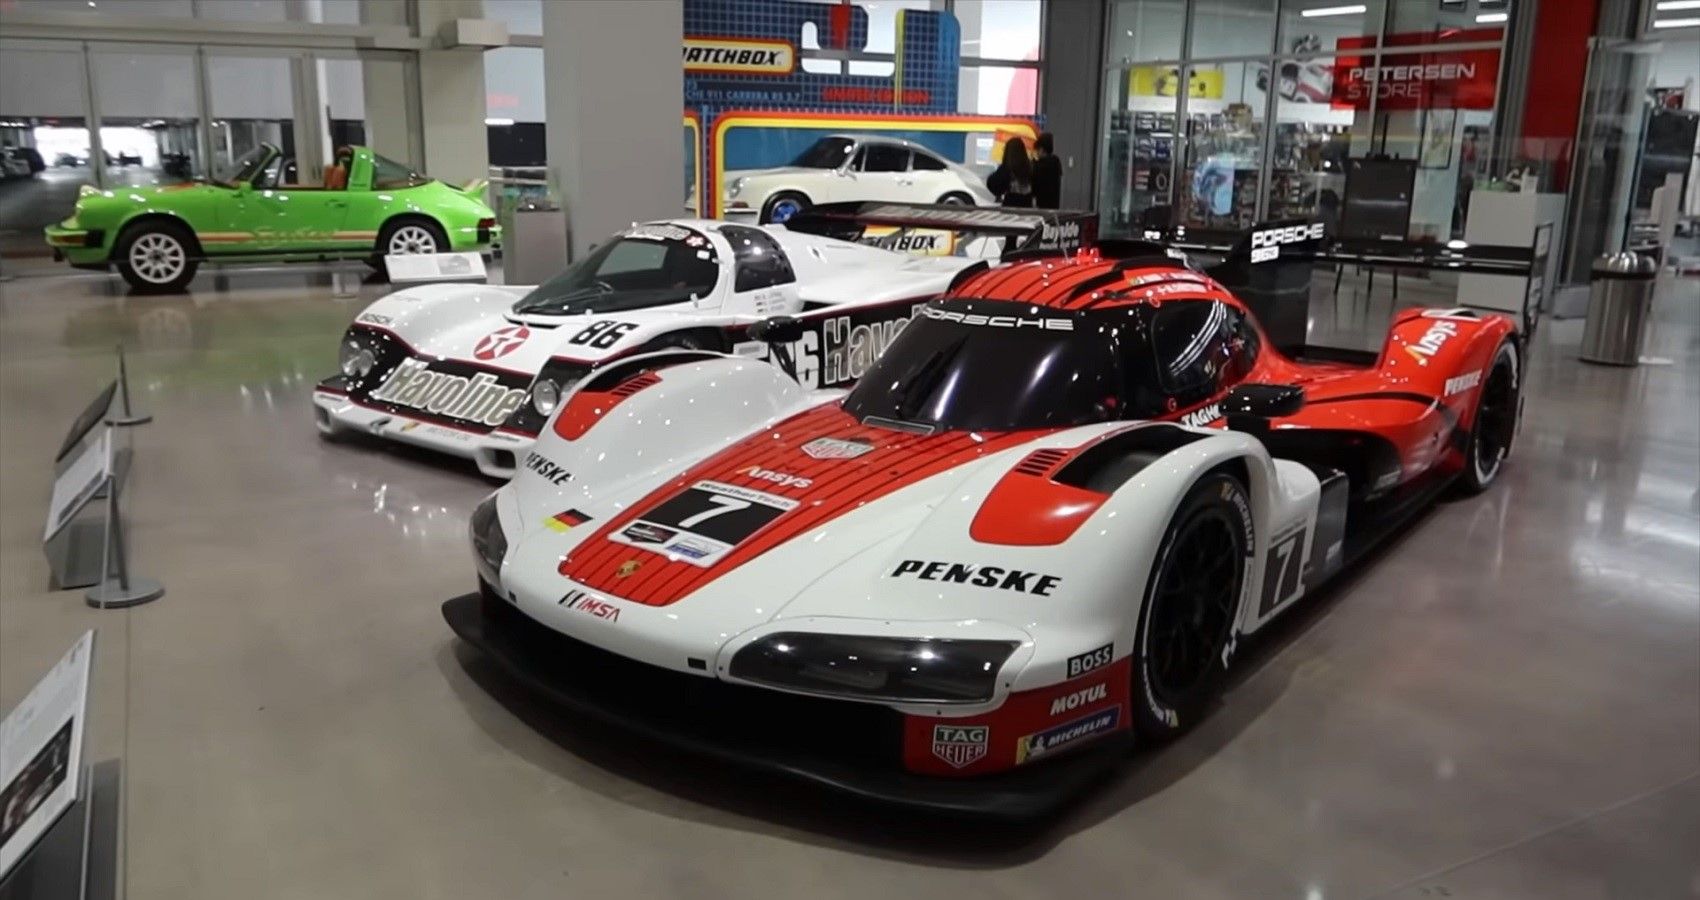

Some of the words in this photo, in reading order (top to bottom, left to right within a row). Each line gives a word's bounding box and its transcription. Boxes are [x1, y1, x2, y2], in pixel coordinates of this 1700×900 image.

[1349, 62, 1475, 81] PETERSEN
[1347, 82, 1420, 99] STORE
[1251, 223, 1324, 248] PORSCHE
[918, 306, 1074, 331] PORSCHE
[568, 320, 638, 349] 86
[371, 357, 527, 426] Havoline
[735, 465, 813, 489] Ansys
[678, 494, 752, 529] 7
[891, 560, 1062, 596] PENSKE
[1273, 537, 1297, 605] 7
[575, 597, 621, 623] IMSA
[1070, 646, 1111, 677] BOSS
[1050, 683, 1107, 716] MOTUL
[940, 728, 984, 743] TAG
[1048, 716, 1111, 748] MICHELIN
[934, 744, 985, 764] HEUER
